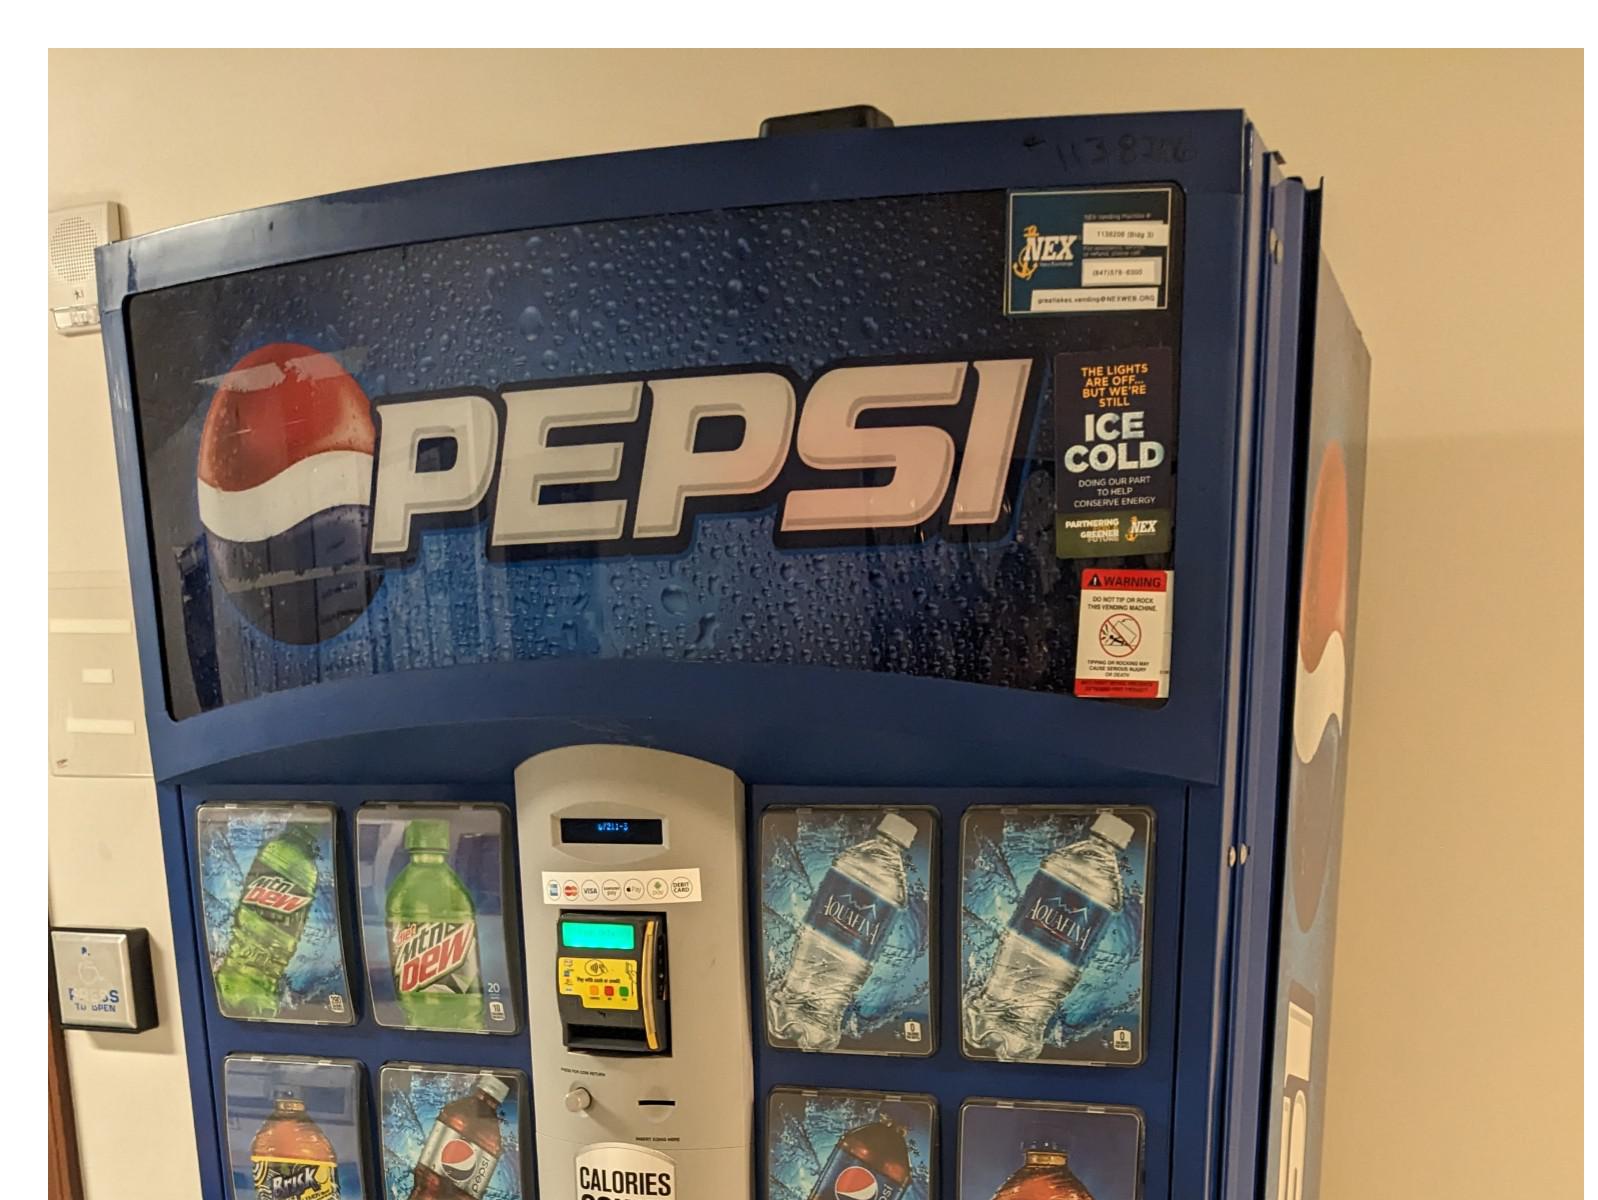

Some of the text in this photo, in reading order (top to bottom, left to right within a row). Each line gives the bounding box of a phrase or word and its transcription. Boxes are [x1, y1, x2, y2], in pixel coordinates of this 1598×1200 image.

[1024, 235, 1078, 261] NEX
[1081, 364, 1148, 377] THE LIGHTS
[1086, 375, 1144, 387] ARE OFF...
[1082, 384, 1147, 398] BUT WE'RE
[1099, 397, 1130, 408] STILL
[1085, 411, 1144, 442] ICE
[370, 359, 1033, 555] PEPSI
[1064, 441, 1165, 473] COLD
[1078, 476, 1151, 488] DOING OUR PART
[1097, 487, 1133, 497] TO HELP
[1074, 496, 1156, 509] CONSERVE ENERGY
[1065, 518, 1119, 529] PARTNERING
[1131, 520, 1158, 533] NEX
[1080, 529, 1119, 539] GREENER
[1103, 576, 1161, 587] WARNING
[825, 894, 881, 945] AQUAFINA
[1030, 897, 1092, 951] AQUAFINA
[488, 983, 500, 993] 20
[92, 1004, 116, 1013] OPEN
[472, 1156, 491, 1194] pepsi
[580, 1166, 671, 1196] CALORIES
